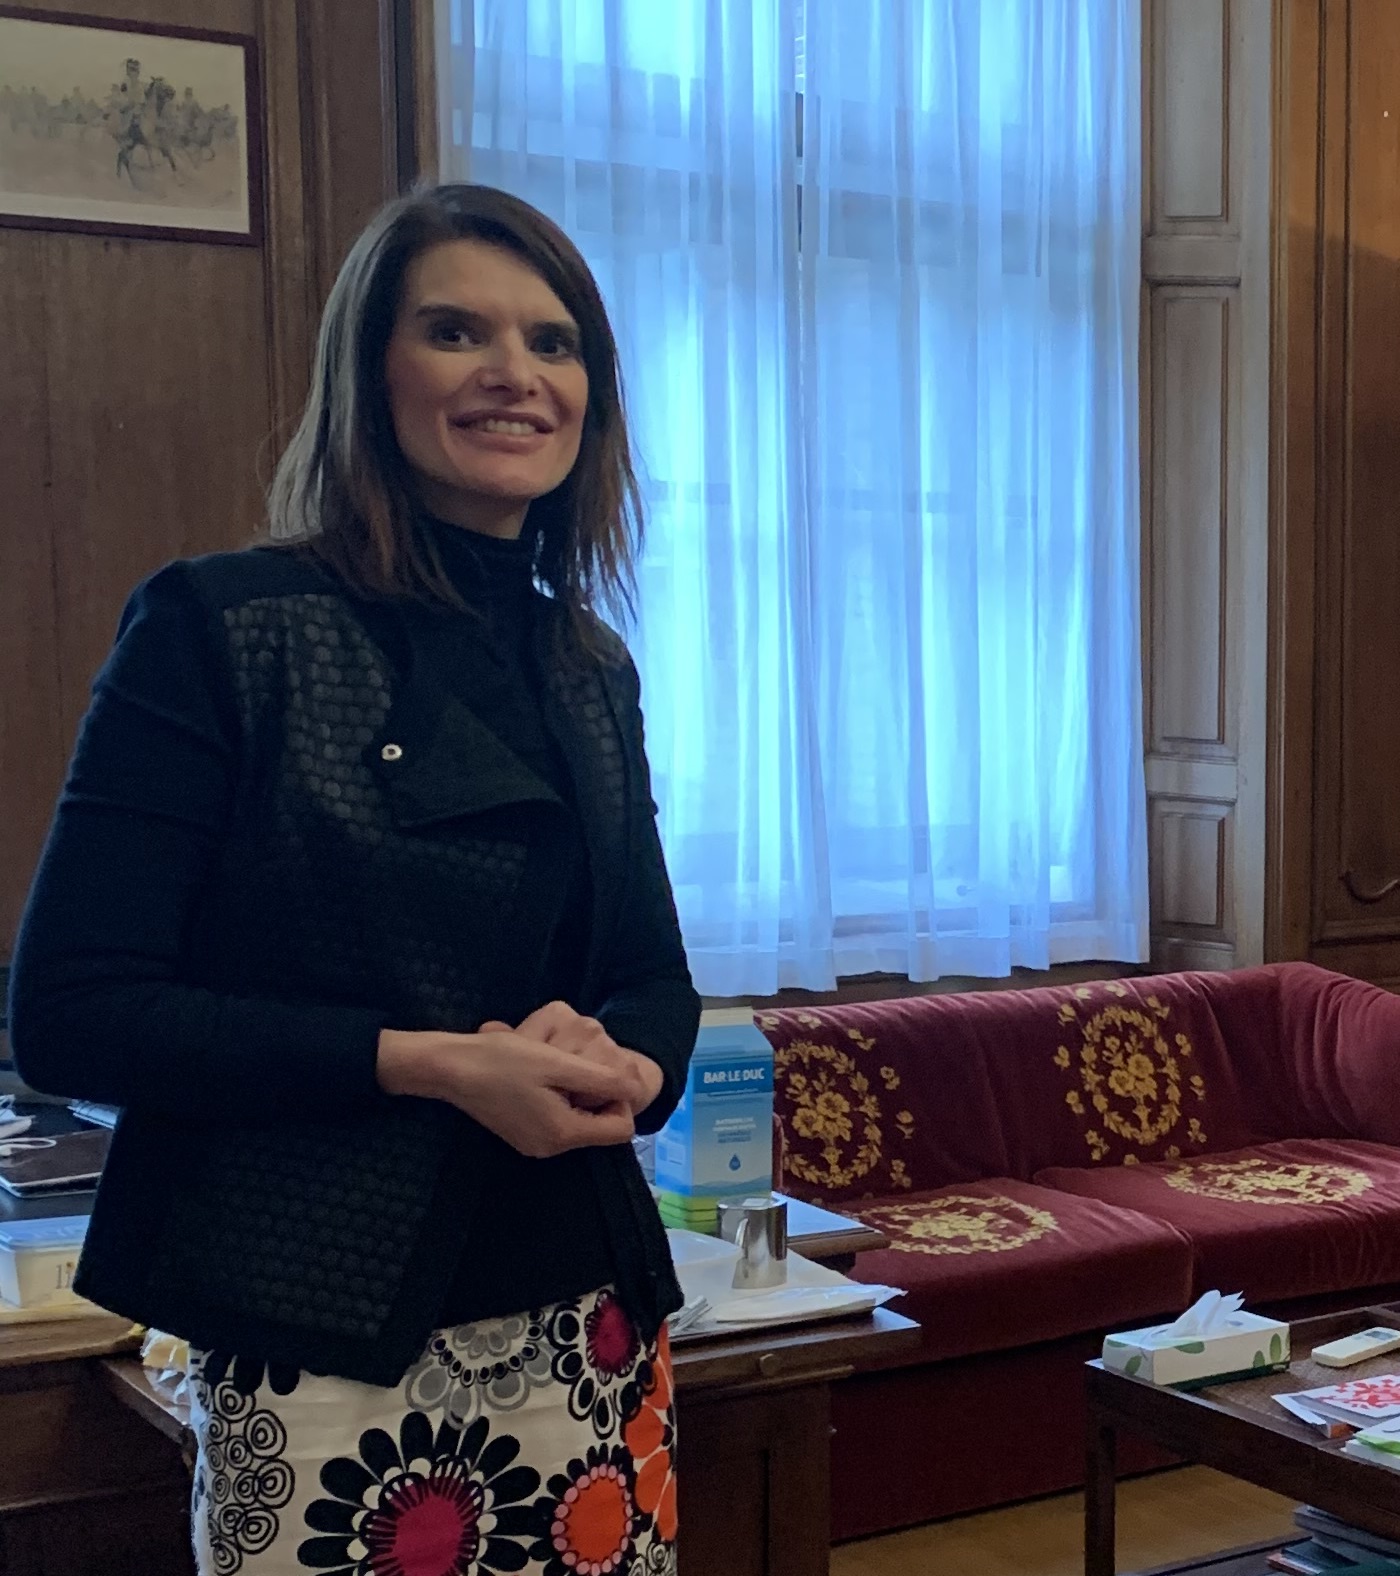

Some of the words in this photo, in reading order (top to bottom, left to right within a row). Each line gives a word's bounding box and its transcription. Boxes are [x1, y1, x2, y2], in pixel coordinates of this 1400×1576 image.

[703, 1071, 727, 1084] BAR
[728, 1070, 741, 1082] LE
[743, 1067, 765, 1081] DUC
